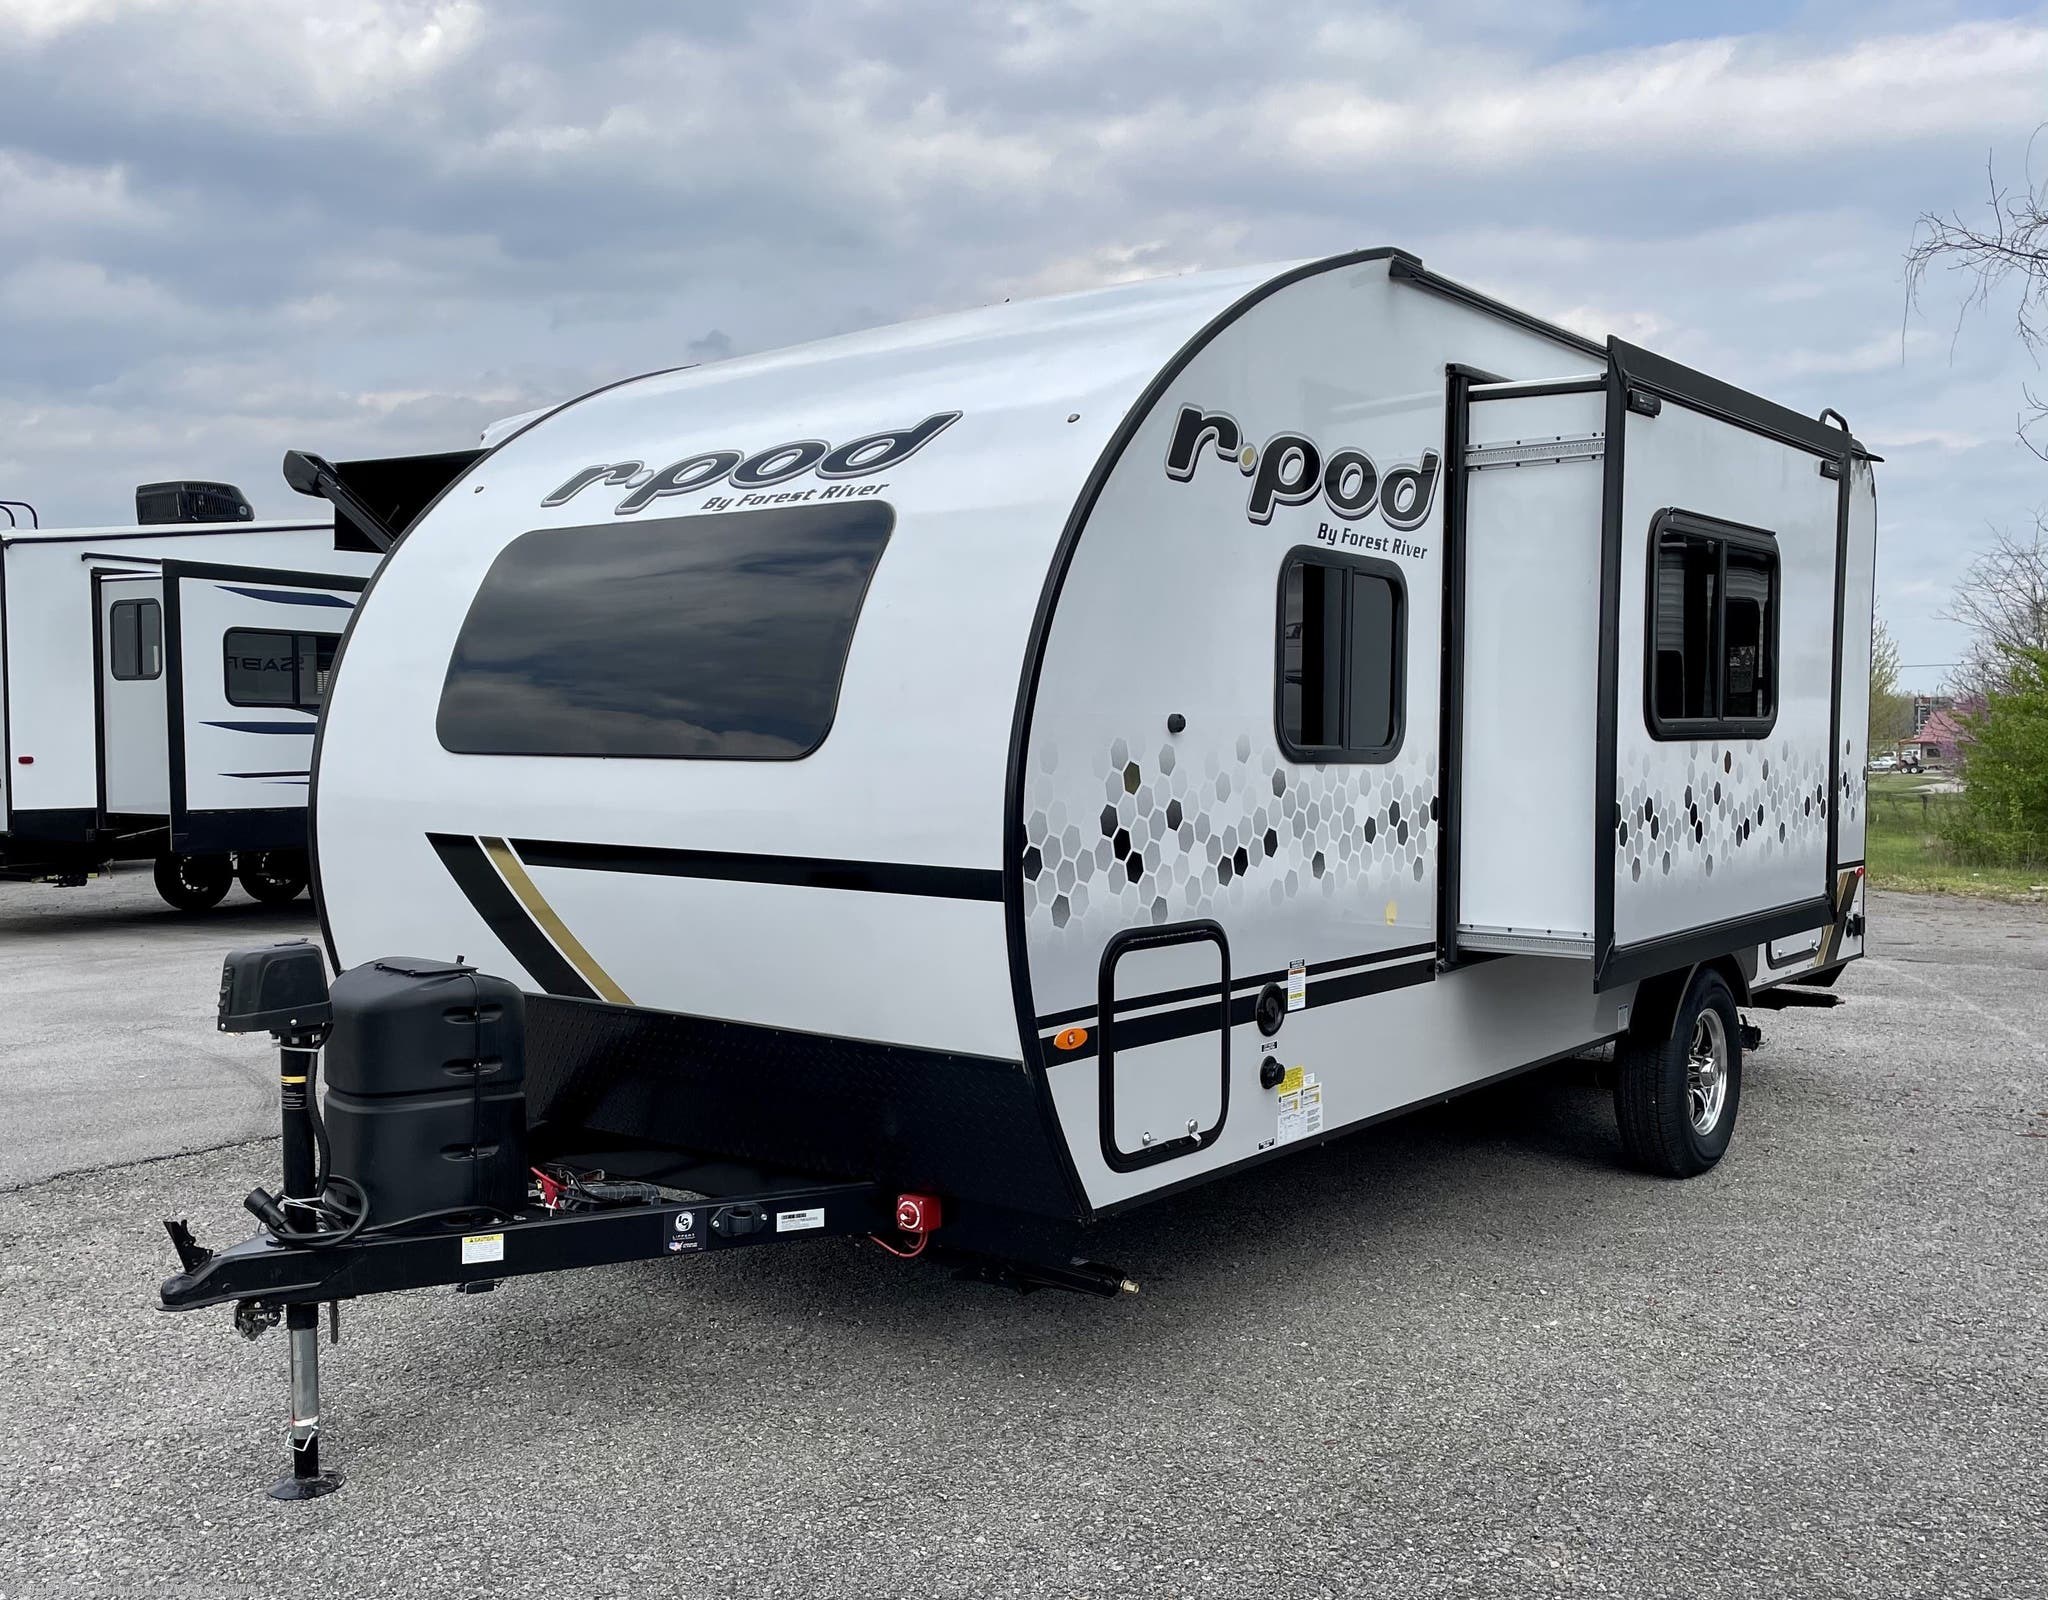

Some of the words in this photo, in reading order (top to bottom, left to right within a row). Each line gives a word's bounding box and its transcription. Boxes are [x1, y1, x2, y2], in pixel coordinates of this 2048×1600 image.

[701, 496, 731, 512] By
[736, 487, 816, 507] Forest
[819, 482, 890, 501] River
[1317, 522, 1338, 546] By
[1341, 527, 1389, 553] Forest
[1392, 539, 1428, 560] River
